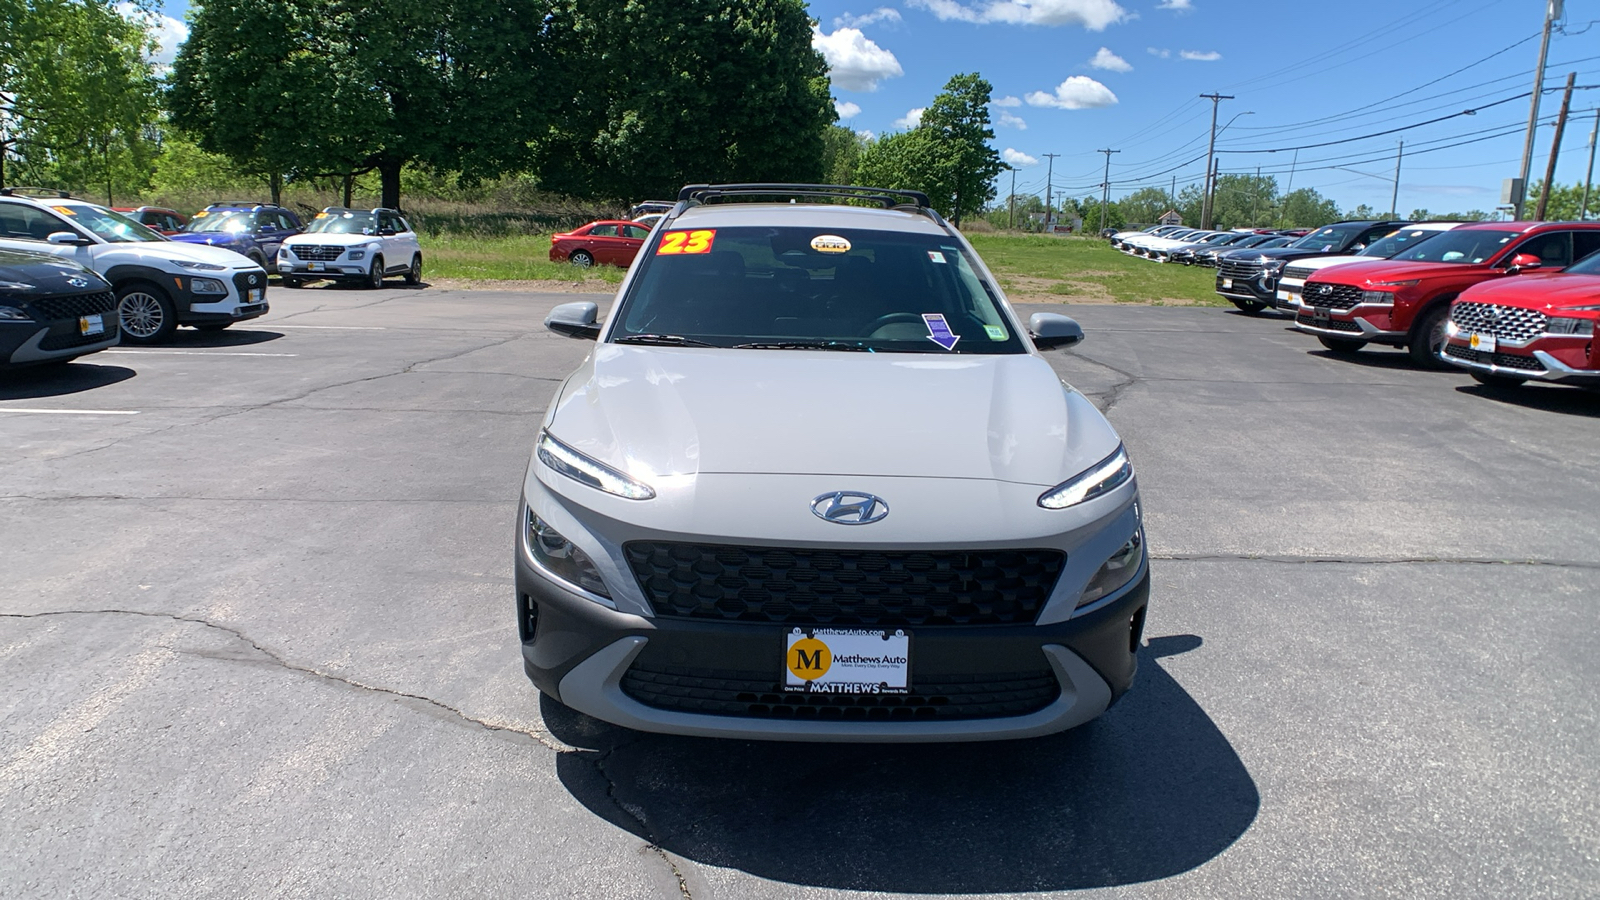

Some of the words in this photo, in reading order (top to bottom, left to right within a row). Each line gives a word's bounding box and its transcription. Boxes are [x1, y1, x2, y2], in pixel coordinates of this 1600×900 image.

[658, 230, 714, 254] 23
[812, 628, 885, 637] MatthewsAuto.com
[794, 649, 823, 670] M
[833, 654, 880, 664] Matthews
[881, 655, 907, 664] Auto
[810, 683, 880, 694] MATTHEWS
